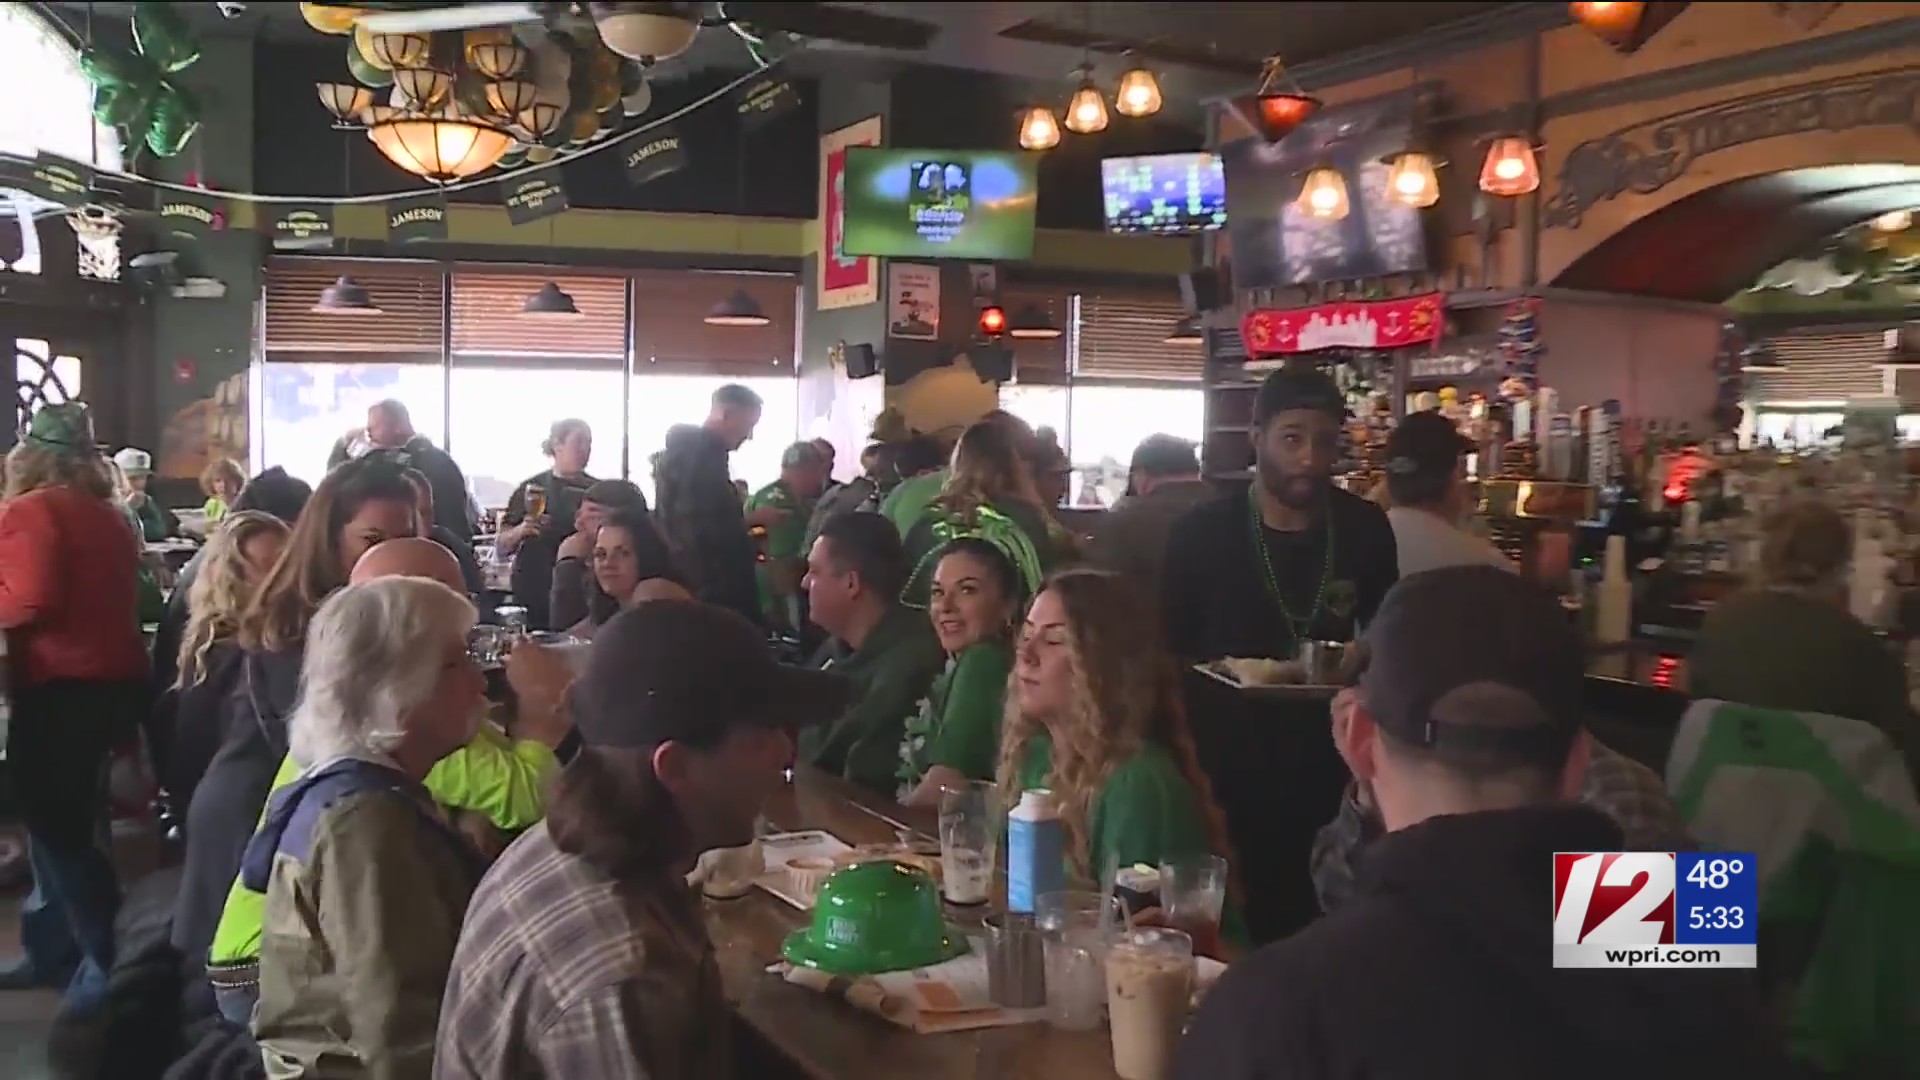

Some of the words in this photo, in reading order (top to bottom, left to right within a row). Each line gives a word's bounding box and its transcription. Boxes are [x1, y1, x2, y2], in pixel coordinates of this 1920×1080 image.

[627, 138, 679, 167] JAMESON
[160, 204, 214, 224] JAMESON
[390, 208, 443, 228] JAMESON
